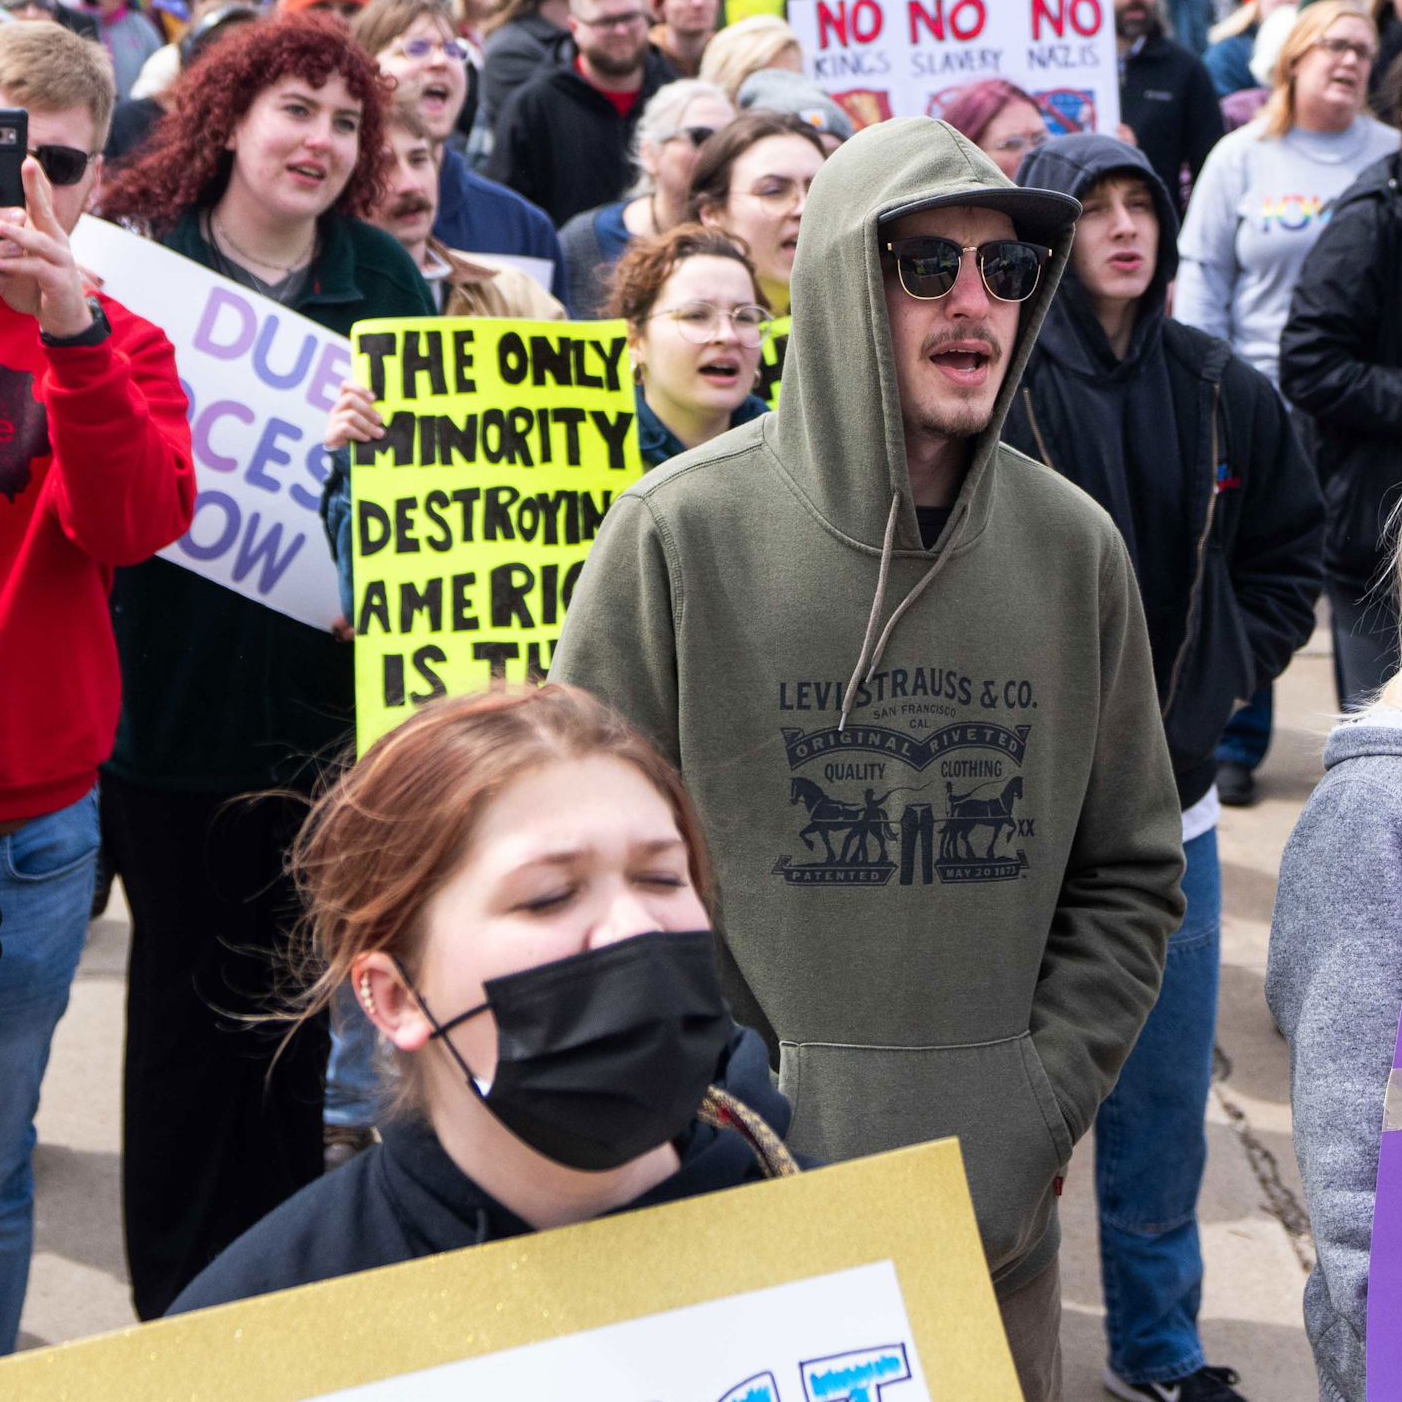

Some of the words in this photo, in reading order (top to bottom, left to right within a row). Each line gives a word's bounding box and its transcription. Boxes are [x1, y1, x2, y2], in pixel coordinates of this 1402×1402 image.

[814, 51, 891, 80] KINGS
[911, 48, 1004, 78] SLAVERY
[1027, 44, 1099, 70] NAZIS
[192, 285, 352, 414] DUE
[358, 331, 476, 401] THE
[498, 332, 628, 391] ONLY
[354, 406, 634, 469] MINORITY
[383, 644, 448, 708] IS
[855, 667, 972, 706] STRAUSS
[979, 680, 999, 709] &
[1003, 679, 1038, 709] CO.
[873, 705, 898, 720] SAN
[901, 703, 957, 719] FRANCISCO
[796, 731, 911, 758] ORIGINAL
[930, 727, 1018, 753] RIVETED
[824, 763, 886, 783] QUALITY
[940, 760, 1002, 779] CLOTHING
[1017, 818, 1035, 838] XX
[792, 870, 880, 881] PATENTED
[946, 868, 971, 879] MAY
[974, 867, 991, 878] 20
